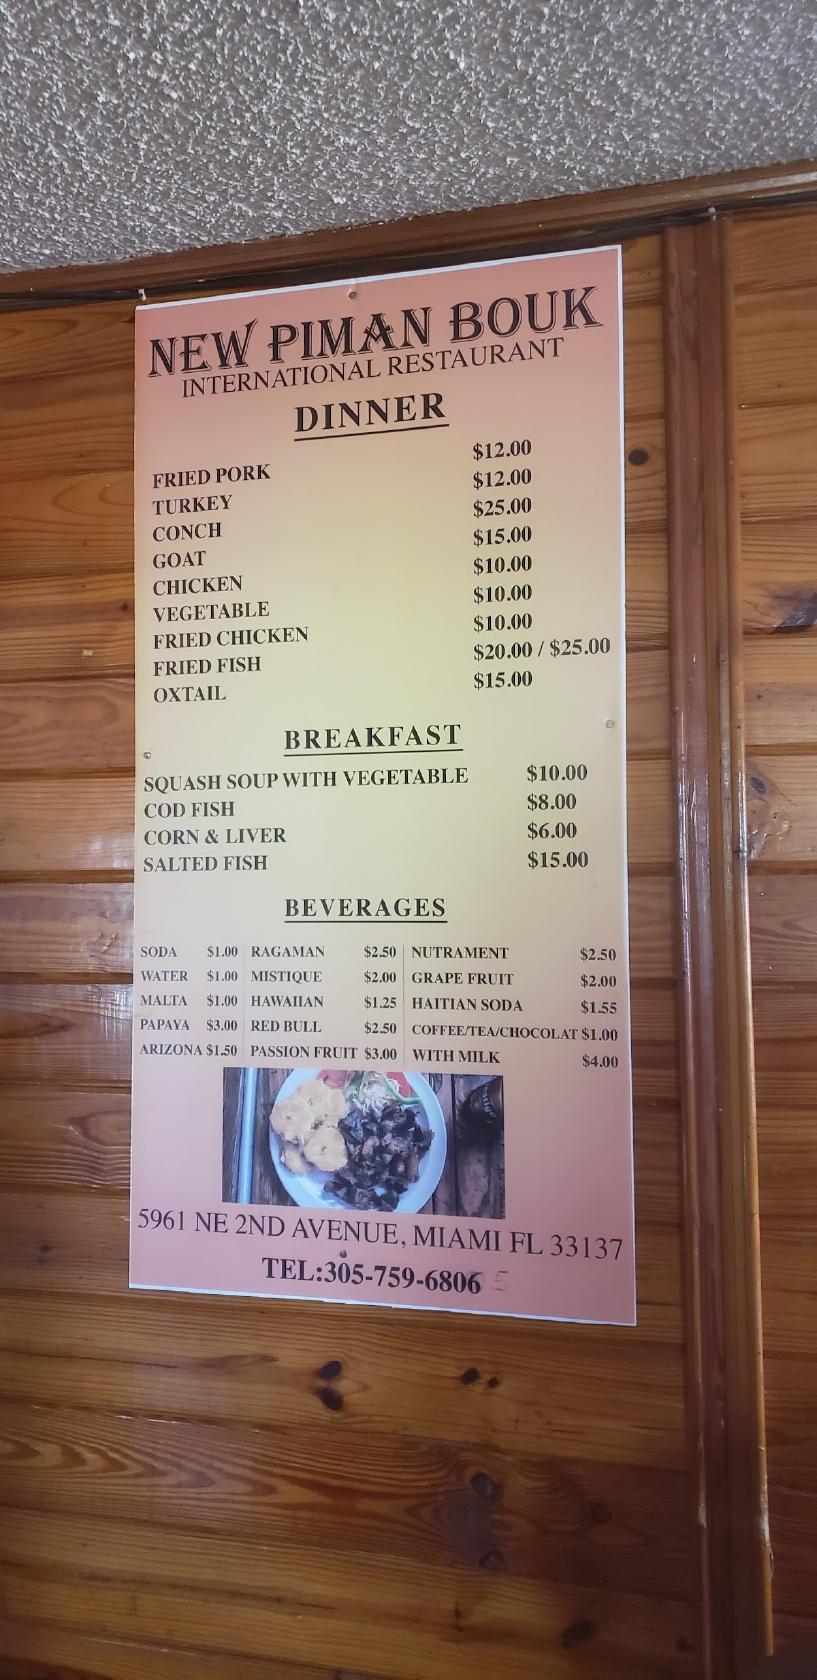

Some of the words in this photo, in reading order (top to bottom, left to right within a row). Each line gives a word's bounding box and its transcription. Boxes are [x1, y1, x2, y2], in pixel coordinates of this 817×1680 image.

[147, 319, 258, 378] NEW
[267, 306, 432, 364] PIMAN
[449, 286, 603, 343] BOUK
[182, 361, 381, 397] INTERNATIONAL
[387, 338, 564, 377] RESTAURANT
[295, 392, 447, 433] DINNER
[473, 440, 532, 460] $12.00
[153, 469, 211, 489] FRIED
[216, 464, 271, 484] PORK
[473, 468, 532, 489] $12.00
[153, 495, 232, 516] TURKEY
[473, 497, 532, 518] $25.00
[153, 522, 222, 542] CONCH
[473, 526, 532, 547] $15.00
[153, 551, 206, 570] GOAT
[473, 555, 532, 575] $10.00
[153, 575, 243, 597] CHICKEN
[473, 584, 532, 604] $10.00
[153, 601, 269, 622] VEGETABLE
[473, 613, 532, 633] $10.00
[153, 631, 212, 650] FRIED
[216, 627, 309, 647] CHICKEN
[473, 642, 533, 662] $20.00
[537, 640, 544, 657] /
[549, 637, 611, 657] $25.00
[153, 658, 212, 677] FRIED
[217, 656, 262, 674] FISH
[473, 670, 533, 691] $15.00
[153, 686, 226, 704] OXTAIL
[284, 724, 462, 751] BREAKFAST
[144, 774, 221, 794] SQUASH
[226, 772, 278, 791] SOUP
[282, 770, 337, 788] WITH
[342, 767, 469, 786] VEGETABLE
[527, 764, 588, 784] $10.00
[144, 802, 186, 819] COD
[191, 801, 235, 818] FISH
[527, 793, 577, 812] $8.00
[144, 828, 200, 846] CORN
[204, 828, 219, 845] &
[225, 827, 286, 845] LIVER
[527, 822, 577, 841] $6.00
[143, 855, 218, 873] SALTED
[223, 854, 268, 871] FISH
[527, 851, 589, 870] $15.00
[284, 898, 446, 918] BEVERAGES
[140, 946, 178, 958] SODA
[207, 944, 238, 959] $1.00
[250, 945, 325, 959] RAGAMAN
[363, 944, 397, 960] $2.50
[411, 946, 510, 960] NUTRAMENT
[580, 946, 616, 963] $2.50
[140, 970, 189, 983] WATER
[207, 969, 238, 984] $1.00
[250, 970, 322, 986] MISTIQUE
[363, 970, 397, 985] $2.00
[411, 971, 463, 985] GRAPE
[467, 972, 514, 986] FRUIT
[580, 973, 617, 989] $2.00
[140, 994, 187, 1007] MALTA
[206, 993, 238, 1008] $1.00
[250, 994, 324, 1008] HAWAIIAN
[363, 995, 397, 1011] $1.25
[412, 997, 477, 1011] HAITIAN
[480, 998, 523, 1012] SODA
[580, 999, 617, 1016] $1.55
[140, 1018, 190, 1032] PAPAYA
[206, 1018, 238, 1033] $3.00
[250, 1019, 280, 1033] RED
[284, 1020, 322, 1033] BULL
[363, 1020, 397, 1036] $2.50
[412, 1023, 578, 1041] COFFEE/TEA/CHOCOLAT
[581, 1026, 618, 1043] $1.00
[139, 1043, 203, 1057] ARIZONA
[206, 1042, 238, 1057] $1.50
[250, 1045, 310, 1059] PASSION
[313, 1046, 358, 1060] FRUIT
[363, 1046, 397, 1061] $3.00
[412, 1049, 454, 1063] WITH
[457, 1050, 501, 1064] MILK
[582, 1054, 619, 1070] $4.00
[137, 1209, 186, 1231] 5961
[195, 1211, 229, 1234] NE
[235, 1214, 286, 1238] 2ND
[291, 1217, 407, 1248] AVENUE,
[412, 1225, 502, 1253] MIAMI
[509, 1231, 543, 1255] FL
[549, 1234, 624, 1261] 33137
